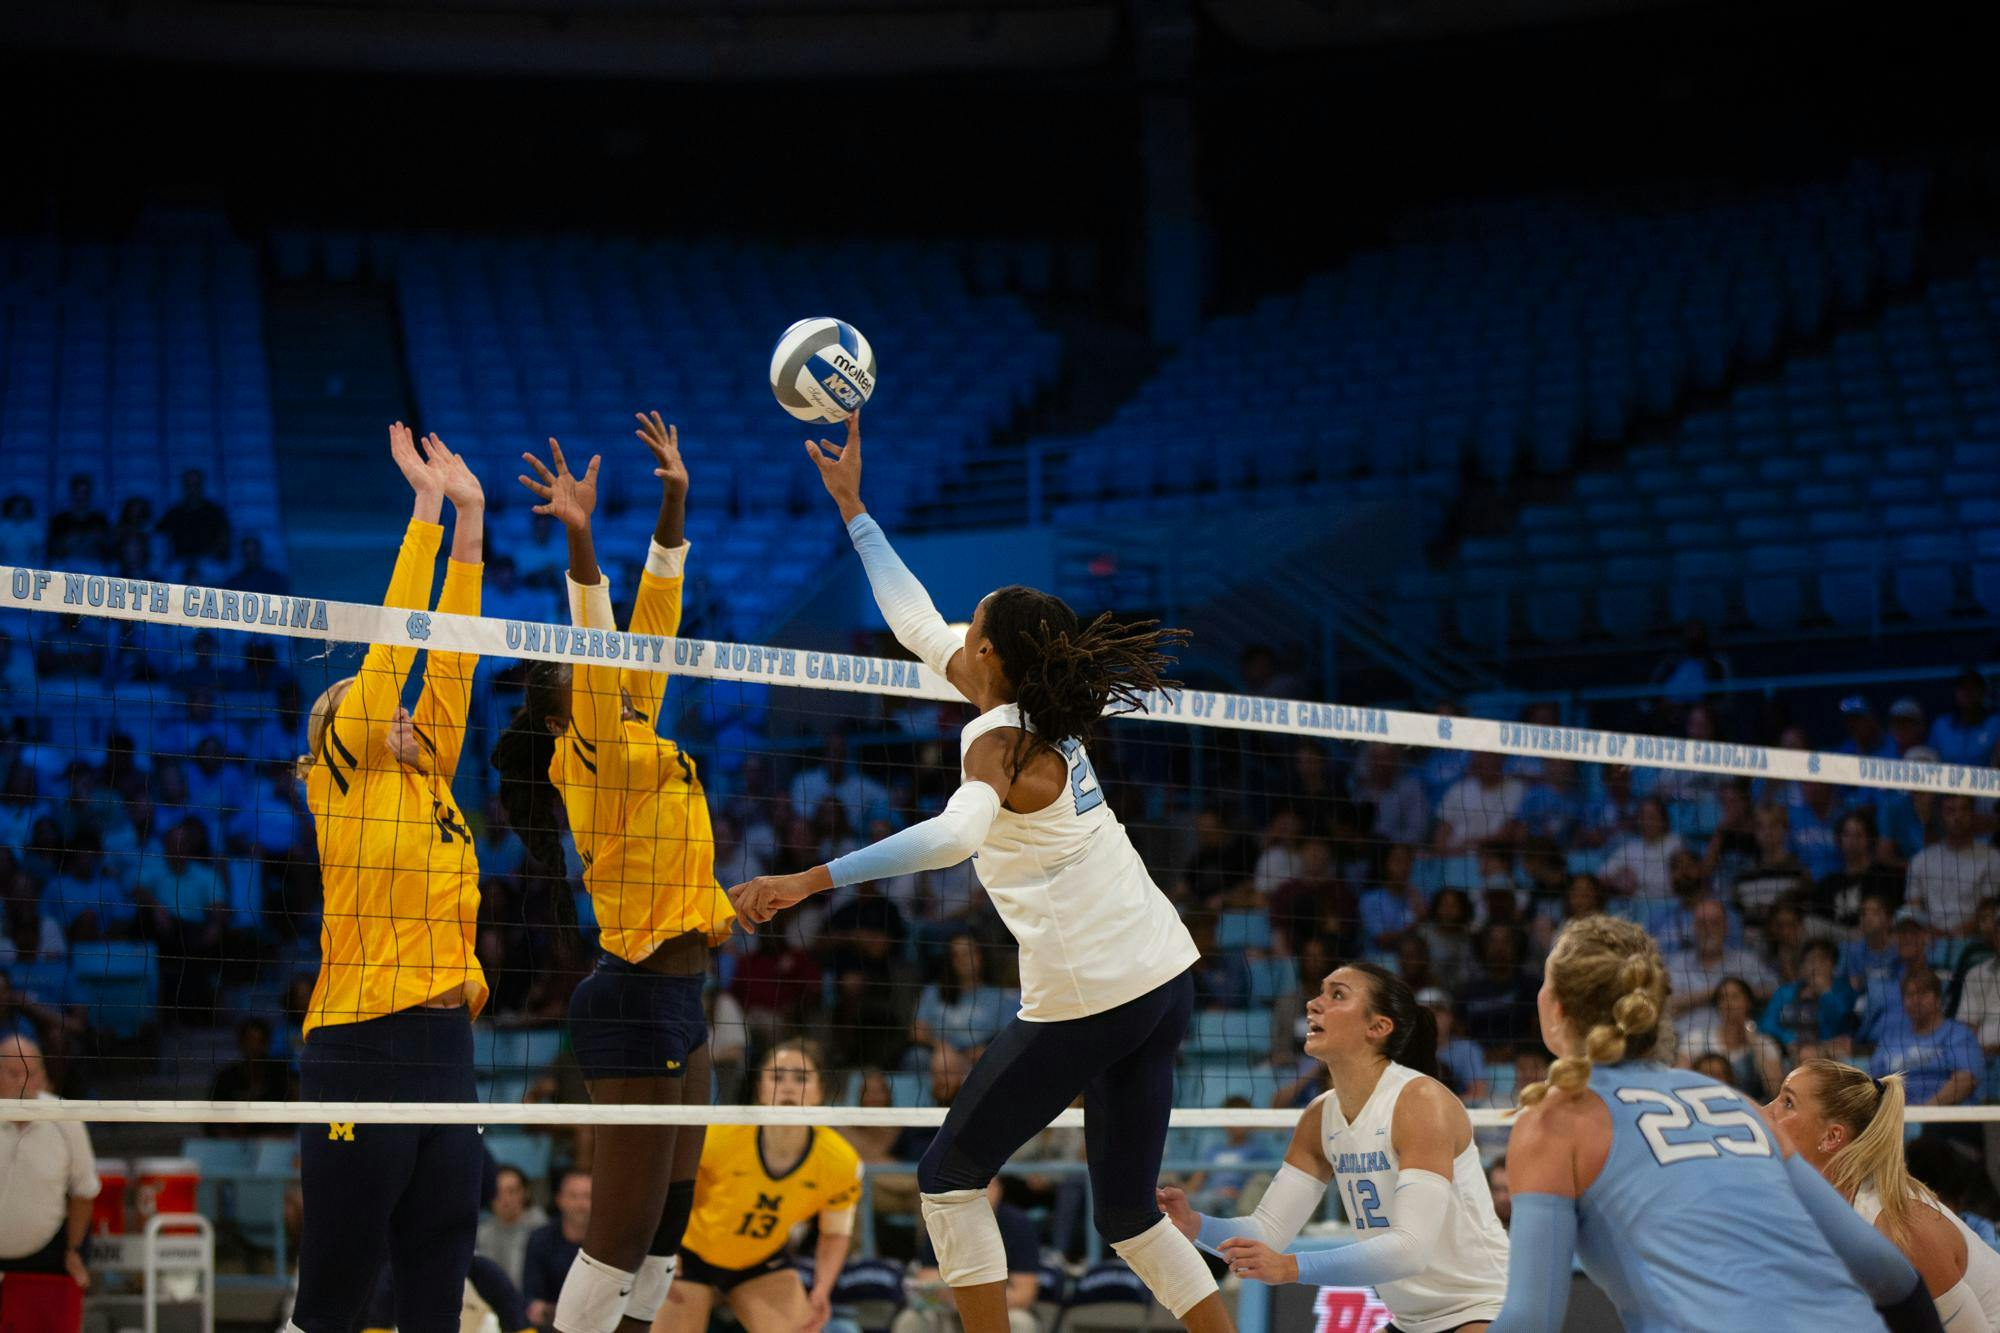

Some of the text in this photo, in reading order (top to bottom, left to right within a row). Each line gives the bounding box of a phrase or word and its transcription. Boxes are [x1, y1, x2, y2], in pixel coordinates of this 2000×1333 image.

[822, 373, 860, 407] NCAA
[833, 355, 872, 395] molten
[12, 568, 328, 630] OF NORTH CAROLINA
[505, 621, 921, 689] UNIVERSITY OF NORTH CAROLINA
[1192, 692, 1216, 717] OF
[1224, 696, 1290, 726] NORTH
[1297, 703, 1389, 735] CAROLINA
[1500, 722, 1768, 770] UNIVERSITY OF NORTH CAROLINA
[1860, 758, 1943, 787] UNIVERSITY
[1947, 765, 1966, 788] OF
[328, 1121, 355, 1141] M
[1614, 1085, 1772, 1168] 25
[735, 1212, 778, 1240] 13
[1347, 1179, 1390, 1230] 12
